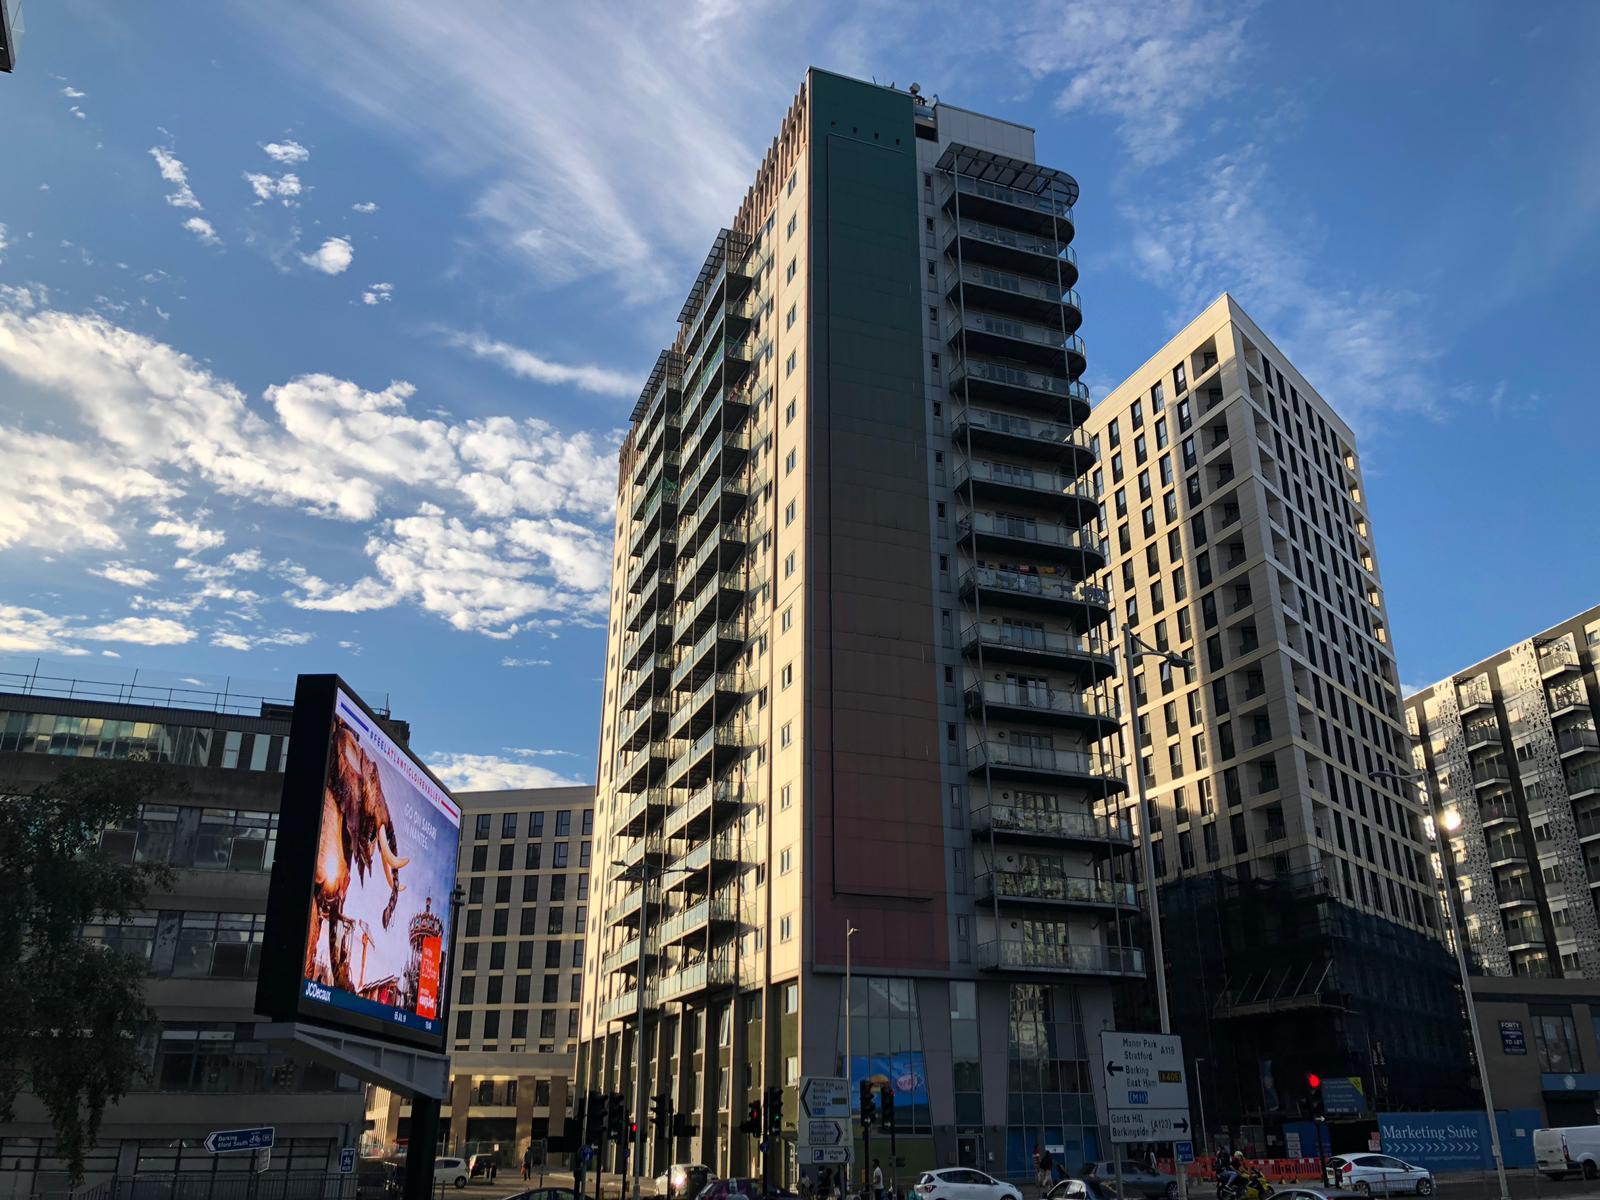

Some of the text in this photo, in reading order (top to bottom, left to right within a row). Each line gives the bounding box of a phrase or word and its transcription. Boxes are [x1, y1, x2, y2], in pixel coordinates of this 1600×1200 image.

[305, 982, 331, 1002] JCDecaux
[1123, 1038, 1158, 1048] Manor Park
[1124, 1051, 1153, 1060] Stratford
[1125, 1065, 1149, 1077] Barking
[1126, 1078, 1158, 1089] East Ham
[1111, 1114, 1144, 1124] Gants Hill
[1382, 1124, 1478, 1142] Marketing Suite
